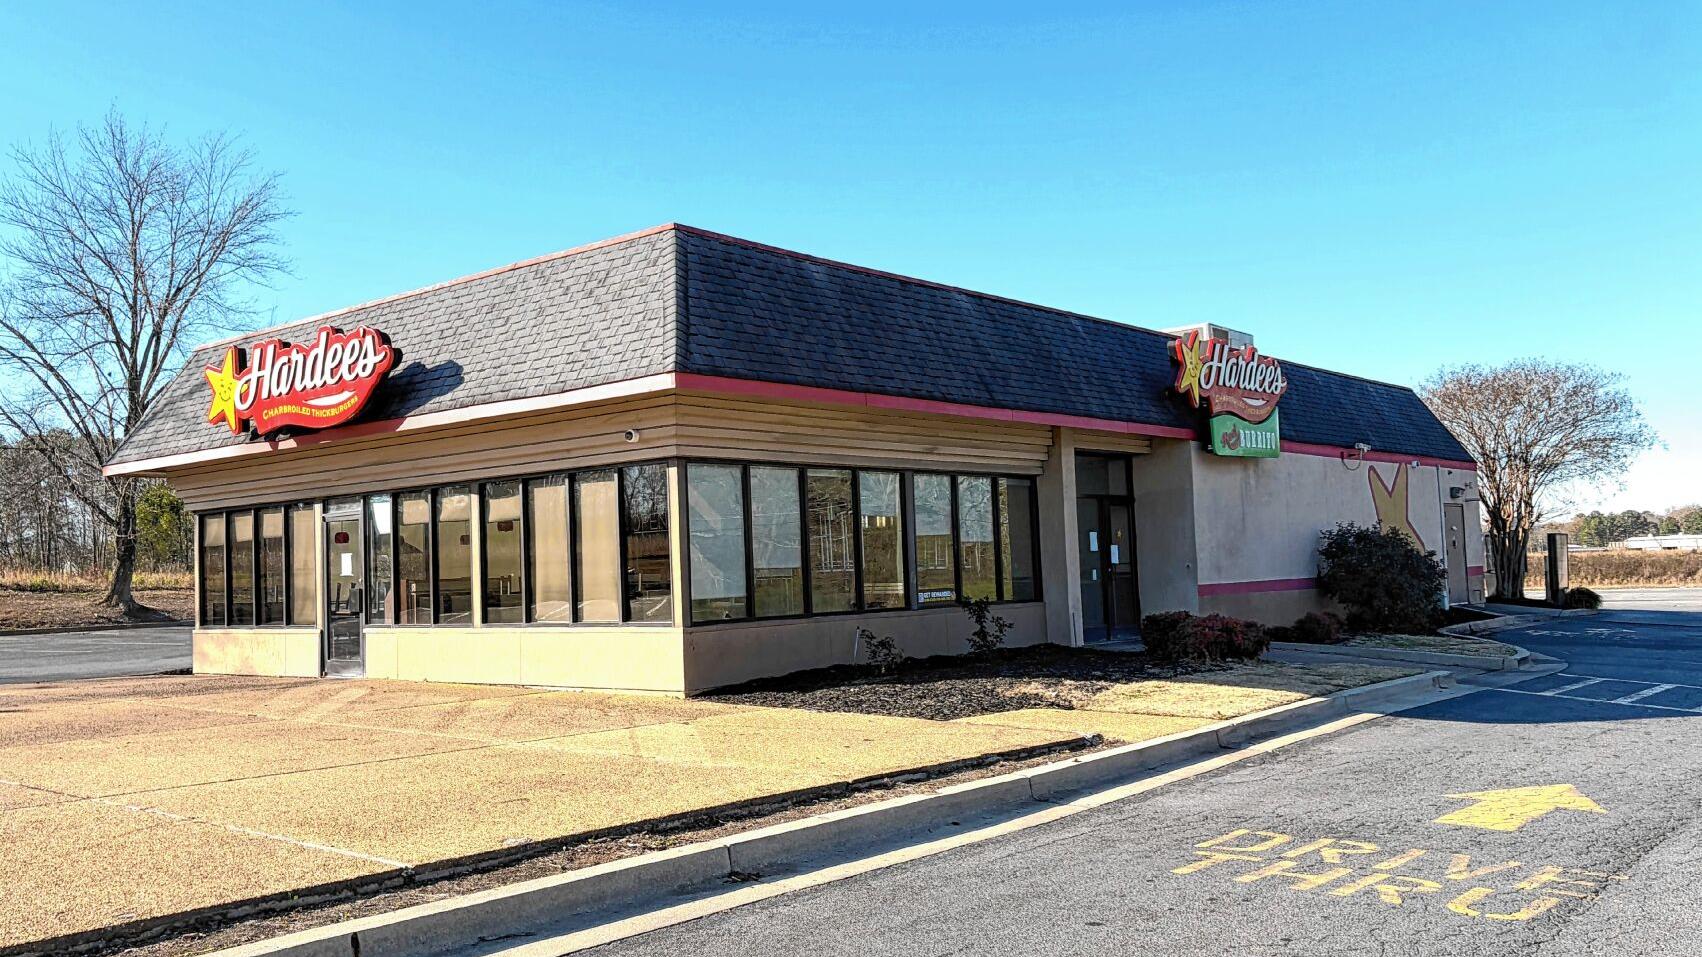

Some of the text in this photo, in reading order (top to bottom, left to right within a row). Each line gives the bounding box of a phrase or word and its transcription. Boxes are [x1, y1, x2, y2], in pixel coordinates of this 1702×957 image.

[235, 329, 386, 411] Hardee's
[1200, 344, 1287, 394] Hardee's
[263, 405, 310, 420] CHARBROILED
[1240, 429, 1276, 449] BURRITO
[1170, 850, 1561, 921] THRU
[1194, 829, 1630, 900] DRIVE
